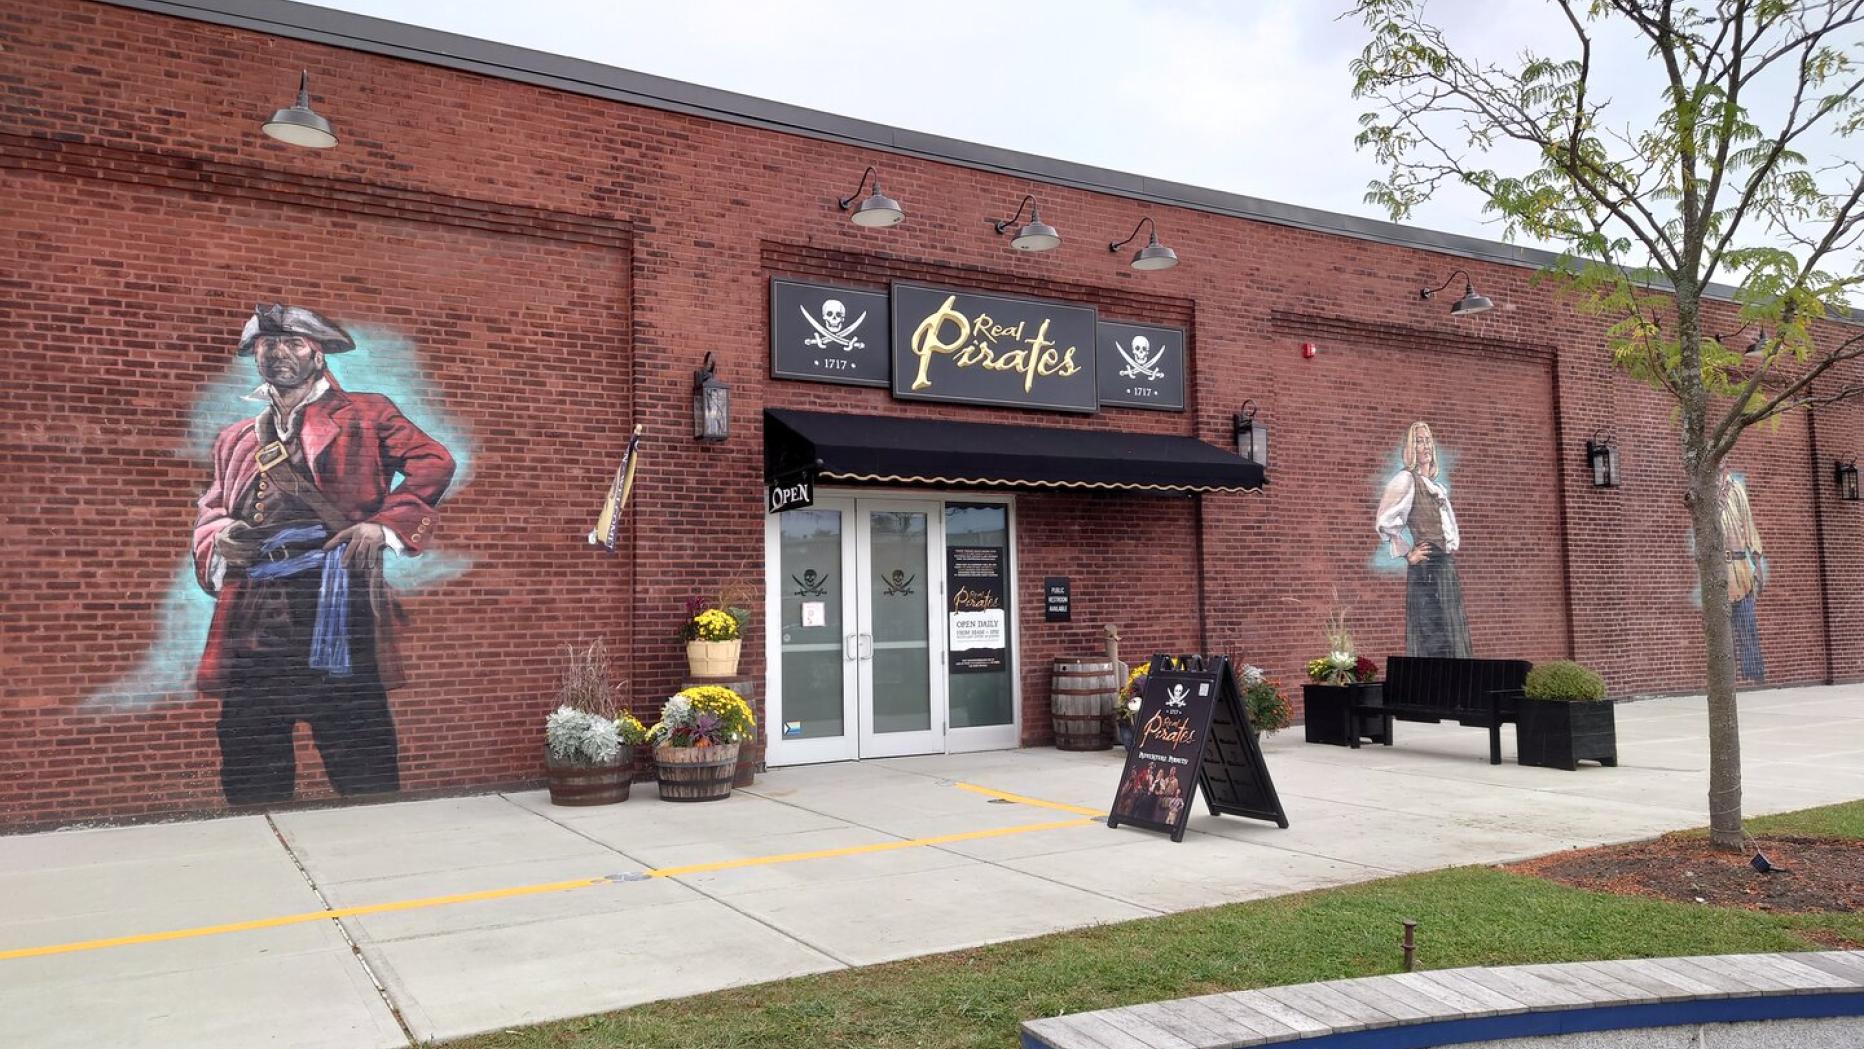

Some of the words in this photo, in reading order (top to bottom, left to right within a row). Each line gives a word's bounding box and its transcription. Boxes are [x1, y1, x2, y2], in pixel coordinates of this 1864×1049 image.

[973, 313, 1026, 344] Real
[911, 295, 1082, 394] Pirates
[824, 358, 847, 370] 1717
[1134, 387, 1152, 397] 1717
[770, 483, 810, 513] OPEN
[956, 620, 976, 628] OPEN
[977, 619, 999, 628] DAILY
[1138, 709, 1197, 751] Pirates
